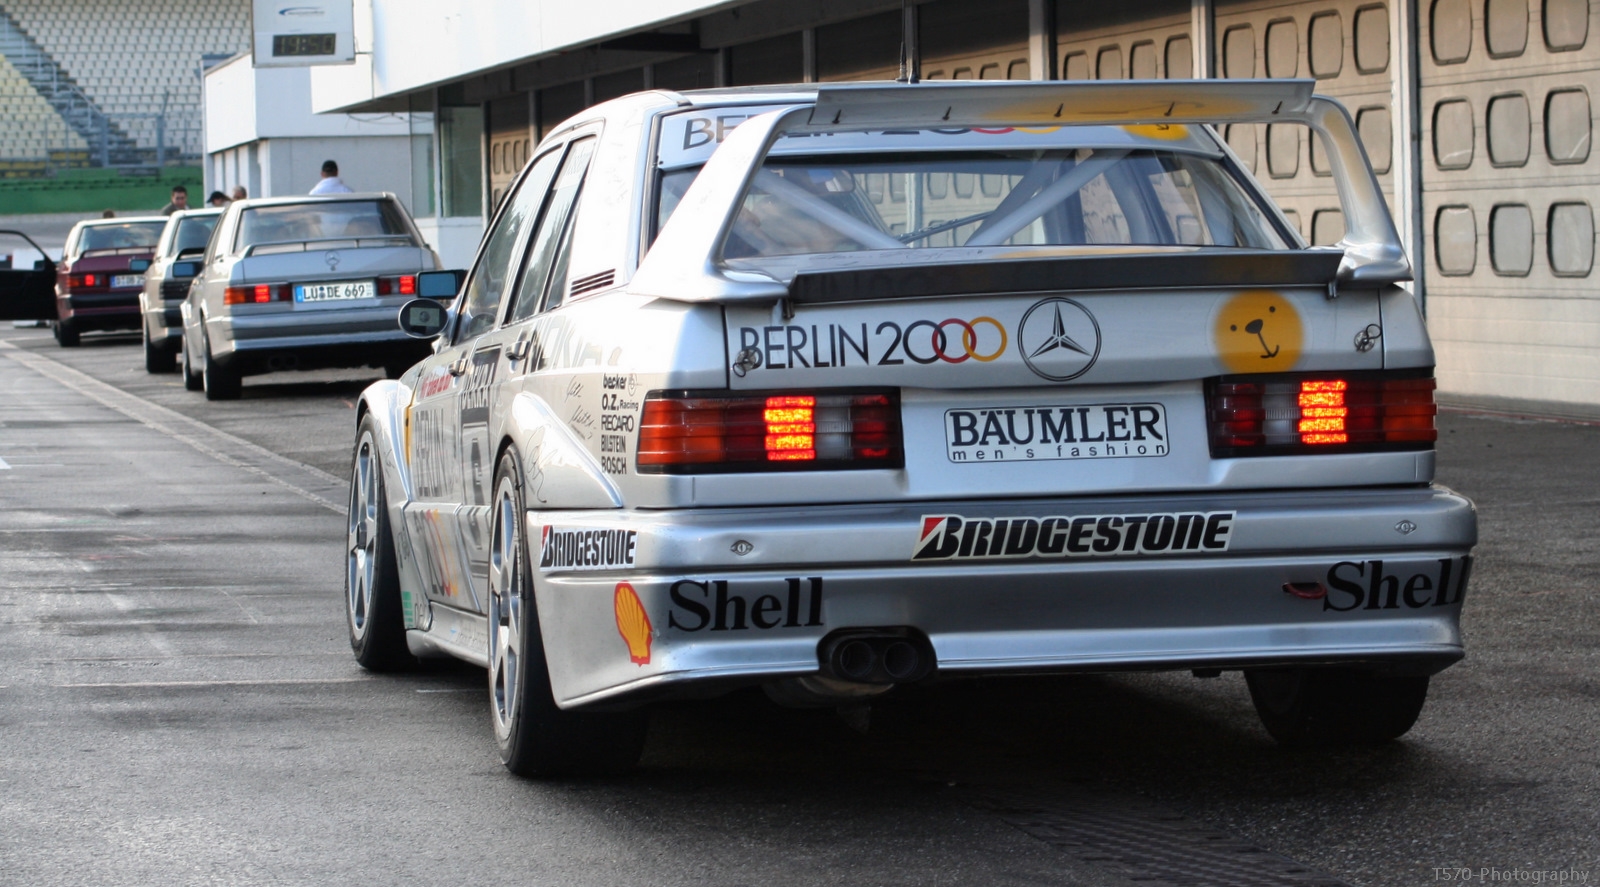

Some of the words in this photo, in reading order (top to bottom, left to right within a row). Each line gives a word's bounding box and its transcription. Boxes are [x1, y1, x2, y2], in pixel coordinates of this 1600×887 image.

[304, 287, 318, 300] LU
[327, 286, 341, 298] DE
[603, 373, 627, 389] becker
[602, 393, 620, 411] O.Z.
[620, 400, 639, 411] Racing
[601, 414, 634, 432] RECARO
[950, 406, 1163, 446] BÄUMLER
[601, 434, 626, 453] BILSTEIN
[952, 446, 1035, 461] men's
[1056, 443, 1166, 458] fashion
[601, 456, 627, 475] BOSCH
[911, 513, 1234, 560] BRIDGESTONE
[540, 525, 637, 568] BRIDGESTONE
[1322, 555, 1474, 612] Shell
[668, 576, 825, 632] Shell
